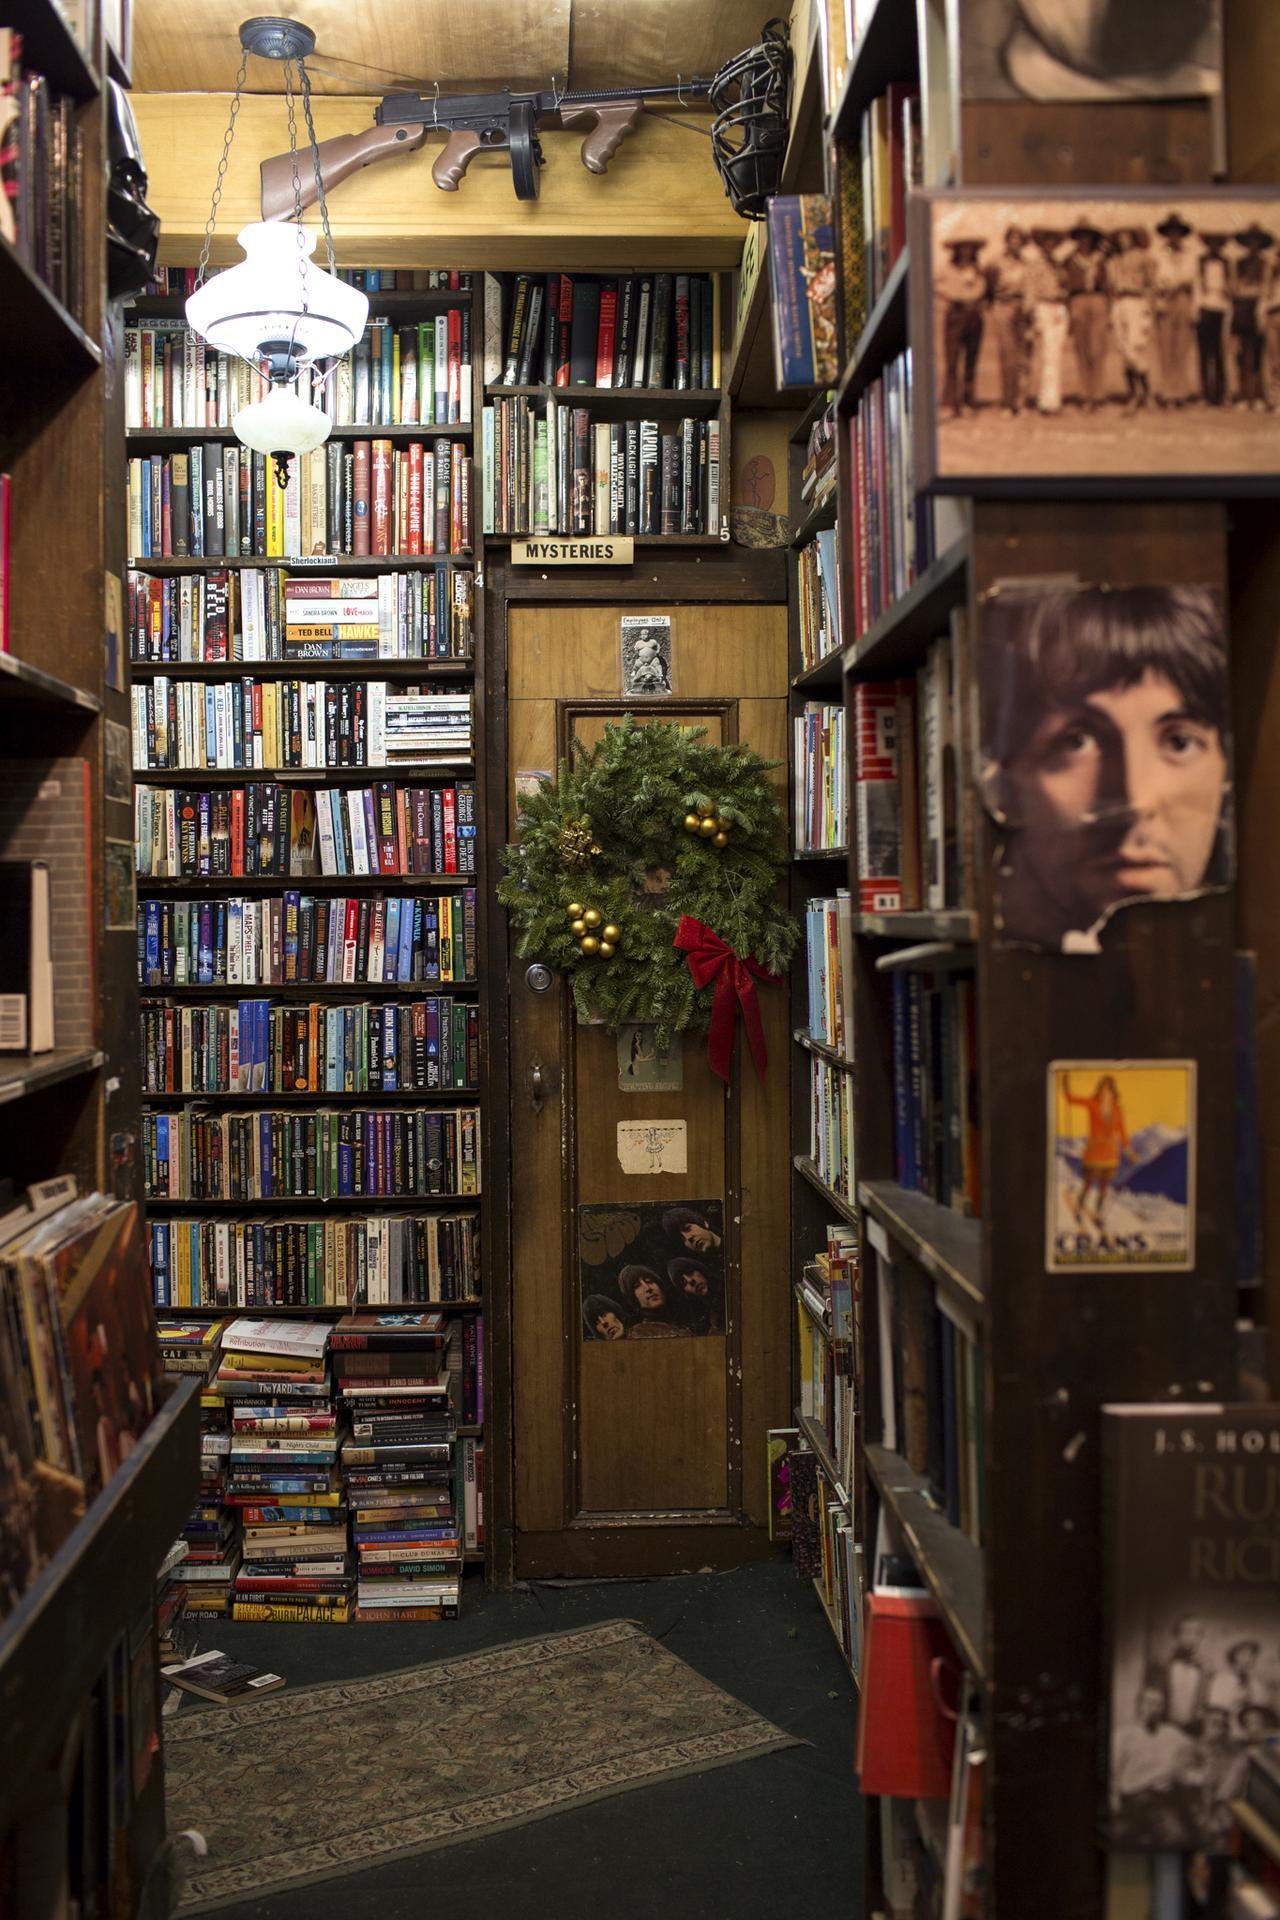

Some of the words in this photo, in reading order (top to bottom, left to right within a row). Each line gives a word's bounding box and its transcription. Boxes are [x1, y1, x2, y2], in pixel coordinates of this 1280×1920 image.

[624, 281, 632, 293] THE
[437, 445, 444, 456] OF
[629, 430, 637, 455] BLACK
[642, 422, 658, 466] CAPONE
[685, 444, 694, 453] for
[629, 457, 637, 479] LIGHT
[685, 455, 694, 486] company
[409, 472, 420, 494] YOUNG
[409, 496, 420, 504] AL
[409, 506, 420, 533] CAPONE
[526, 543, 614, 559] MYSTERIES
[291, 556, 337, 565] Sherlockiana
[295, 586, 309, 594] DAN
[309, 586, 330, 594] BROWN
[207, 584, 217, 619] BELL
[215, 588, 225, 614] TED
[321, 608, 338, 616] BROWN
[342, 607, 358, 616] LOVE
[315, 628, 332, 636] BELL
[339, 625, 379, 640] HAWKE
[304, 643, 322, 651] DAN
[280, 794, 288, 806] KEN
[381, 798, 391, 811] JOHN
[458, 794, 466, 823] GEORGE
[466, 795, 474, 822] Elizabeth
[280, 807, 288, 833] FOLLETT
[382, 812, 392, 836] GRISHAM
[459, 847, 467, 871] DEATH
[464, 901, 475, 925] ROBERT
[244, 913, 253, 935] MAPS
[414, 907, 422, 941] KATWALK
[244, 940, 253, 956] HELL
[464, 927, 475, 955] LUDLUM
[316, 944, 325, 973] HANGMAN
[385, 1008, 394, 1027] JOHN
[385, 1029, 394, 1055] NICHOL
[371, 1055, 380, 1069] Clock
[342, 1150, 350, 1164] LAST
[342, 1165, 350, 1184] RIGHTS
[337, 1234, 345, 1258] CLEA'S
[337, 1260, 345, 1281] MOON
[229, 1338, 266, 1349] Retribution
[162, 1350, 182, 1358] CAT
[259, 1383, 271, 1394] The
[271, 1383, 293, 1394] YARD
[286, 1440, 304, 1449] Night's
[304, 1441, 320, 1449] Child
[1155, 1429, 1205, 1455] J.S.
[1195, 1463, 1280, 1521] RU
[361, 1567, 396, 1575] HOMICIDE
[422, 1564, 446, 1572] SIMON
[249, 1593, 265, 1601] FURST
[182, 1610, 198, 1619] LOW
[199, 1610, 218, 1619] ROAD
[271, 1608, 297, 1621] BURN
[296, 1605, 336, 1622] PALACE
[365, 1611, 391, 1619] JOHN
[393, 1610, 417, 1619] HART
